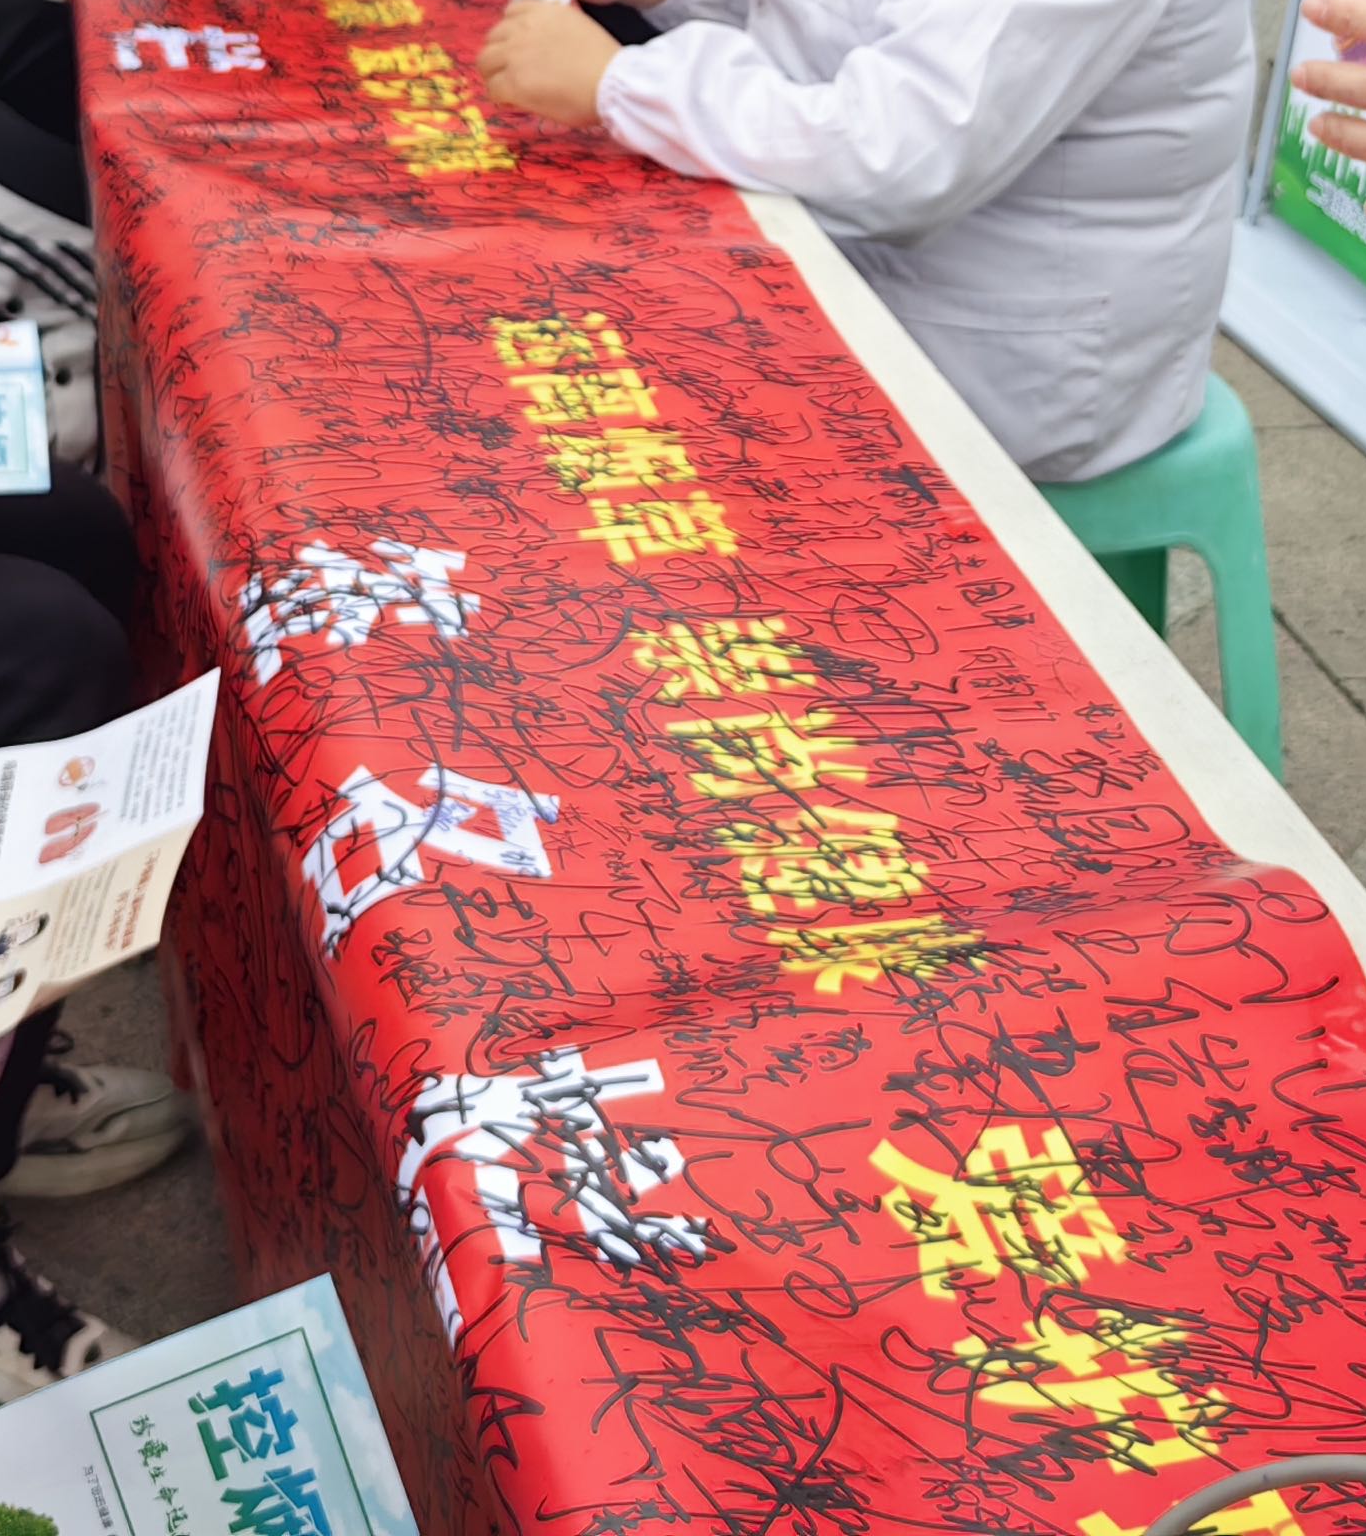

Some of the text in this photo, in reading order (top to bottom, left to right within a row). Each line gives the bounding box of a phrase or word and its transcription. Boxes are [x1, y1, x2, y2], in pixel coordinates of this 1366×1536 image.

[489, 311, 739, 564] 远离烟草
[628, 618, 993, 995] 崇尚健康
[187, 1365, 334, 1536] 控烟
